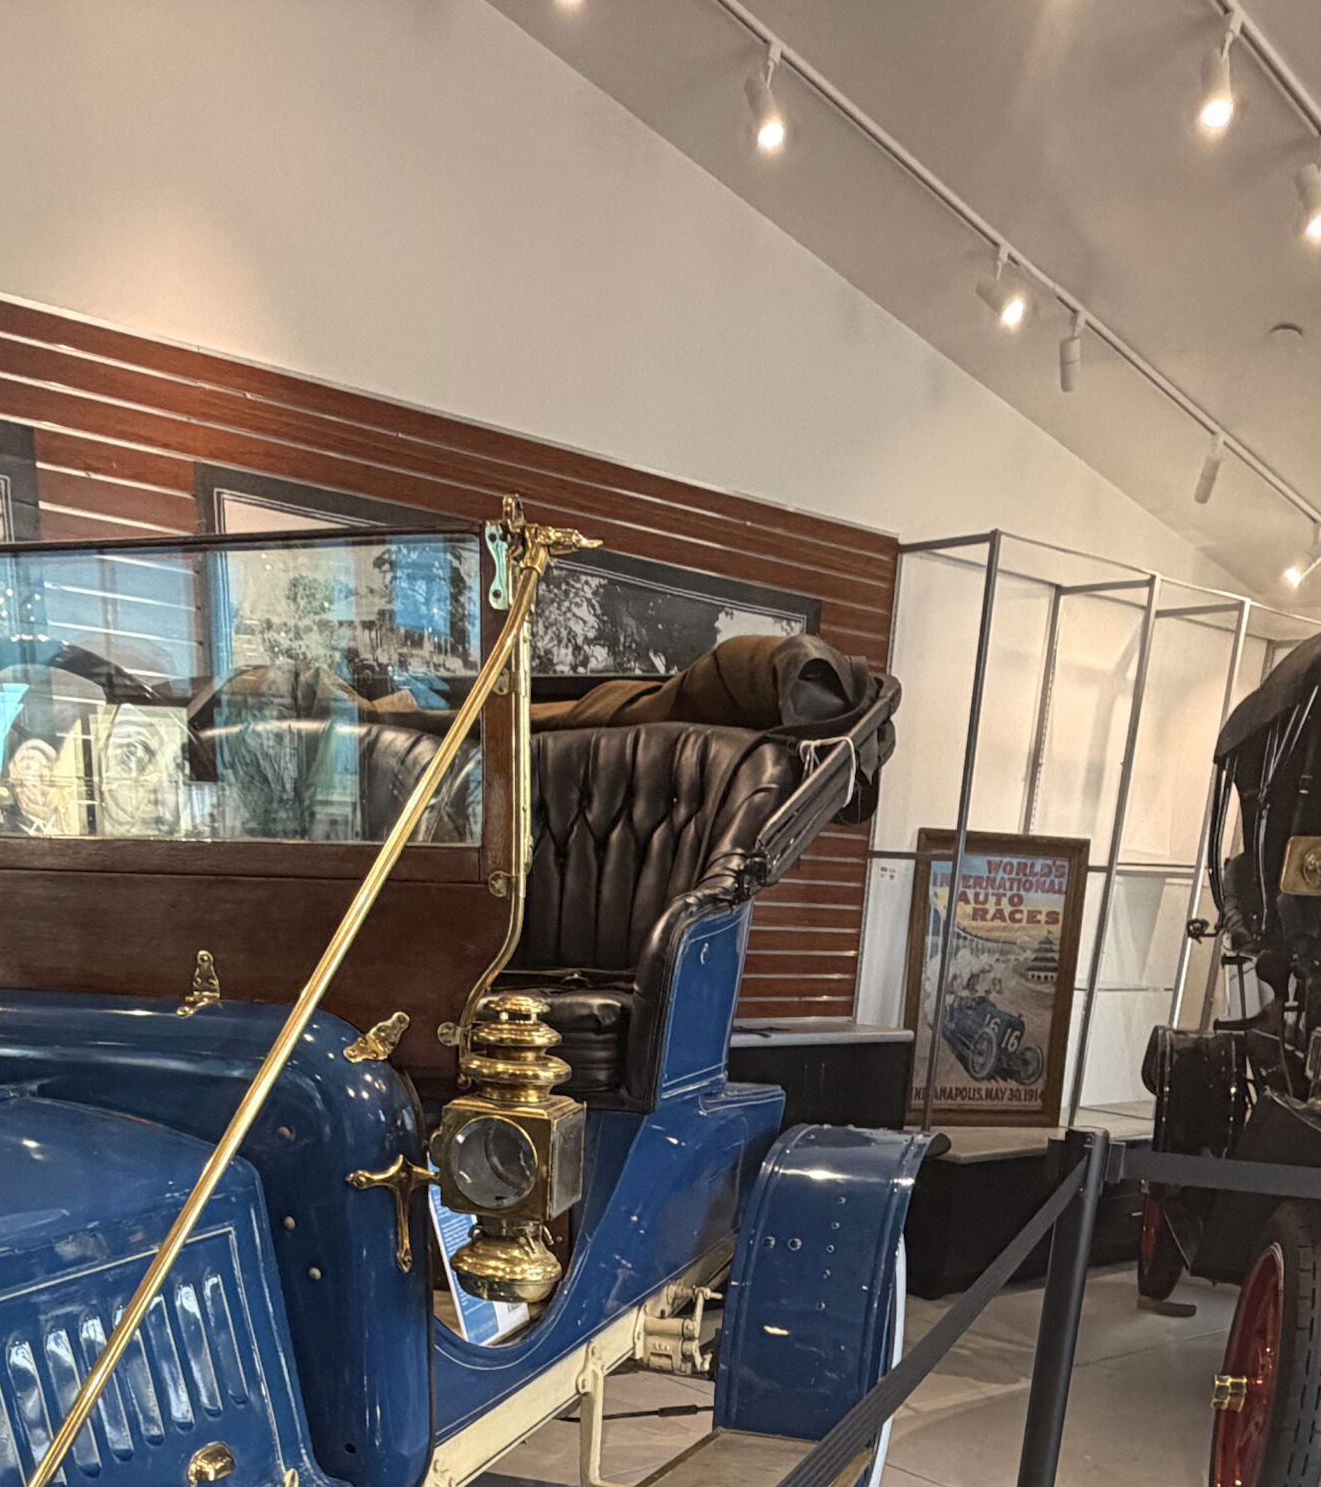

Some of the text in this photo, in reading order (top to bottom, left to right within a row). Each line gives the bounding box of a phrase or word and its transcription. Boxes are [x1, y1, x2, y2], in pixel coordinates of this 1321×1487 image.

[986, 859, 1066, 878] WORLD'S
[932, 872, 1067, 894] INERNATIONAL
[958, 890, 1024, 907] AUTO
[972, 906, 1060, 925] RACES
[1001, 1027, 1021, 1052] 16
[985, 1087, 1007, 1102] MAY
